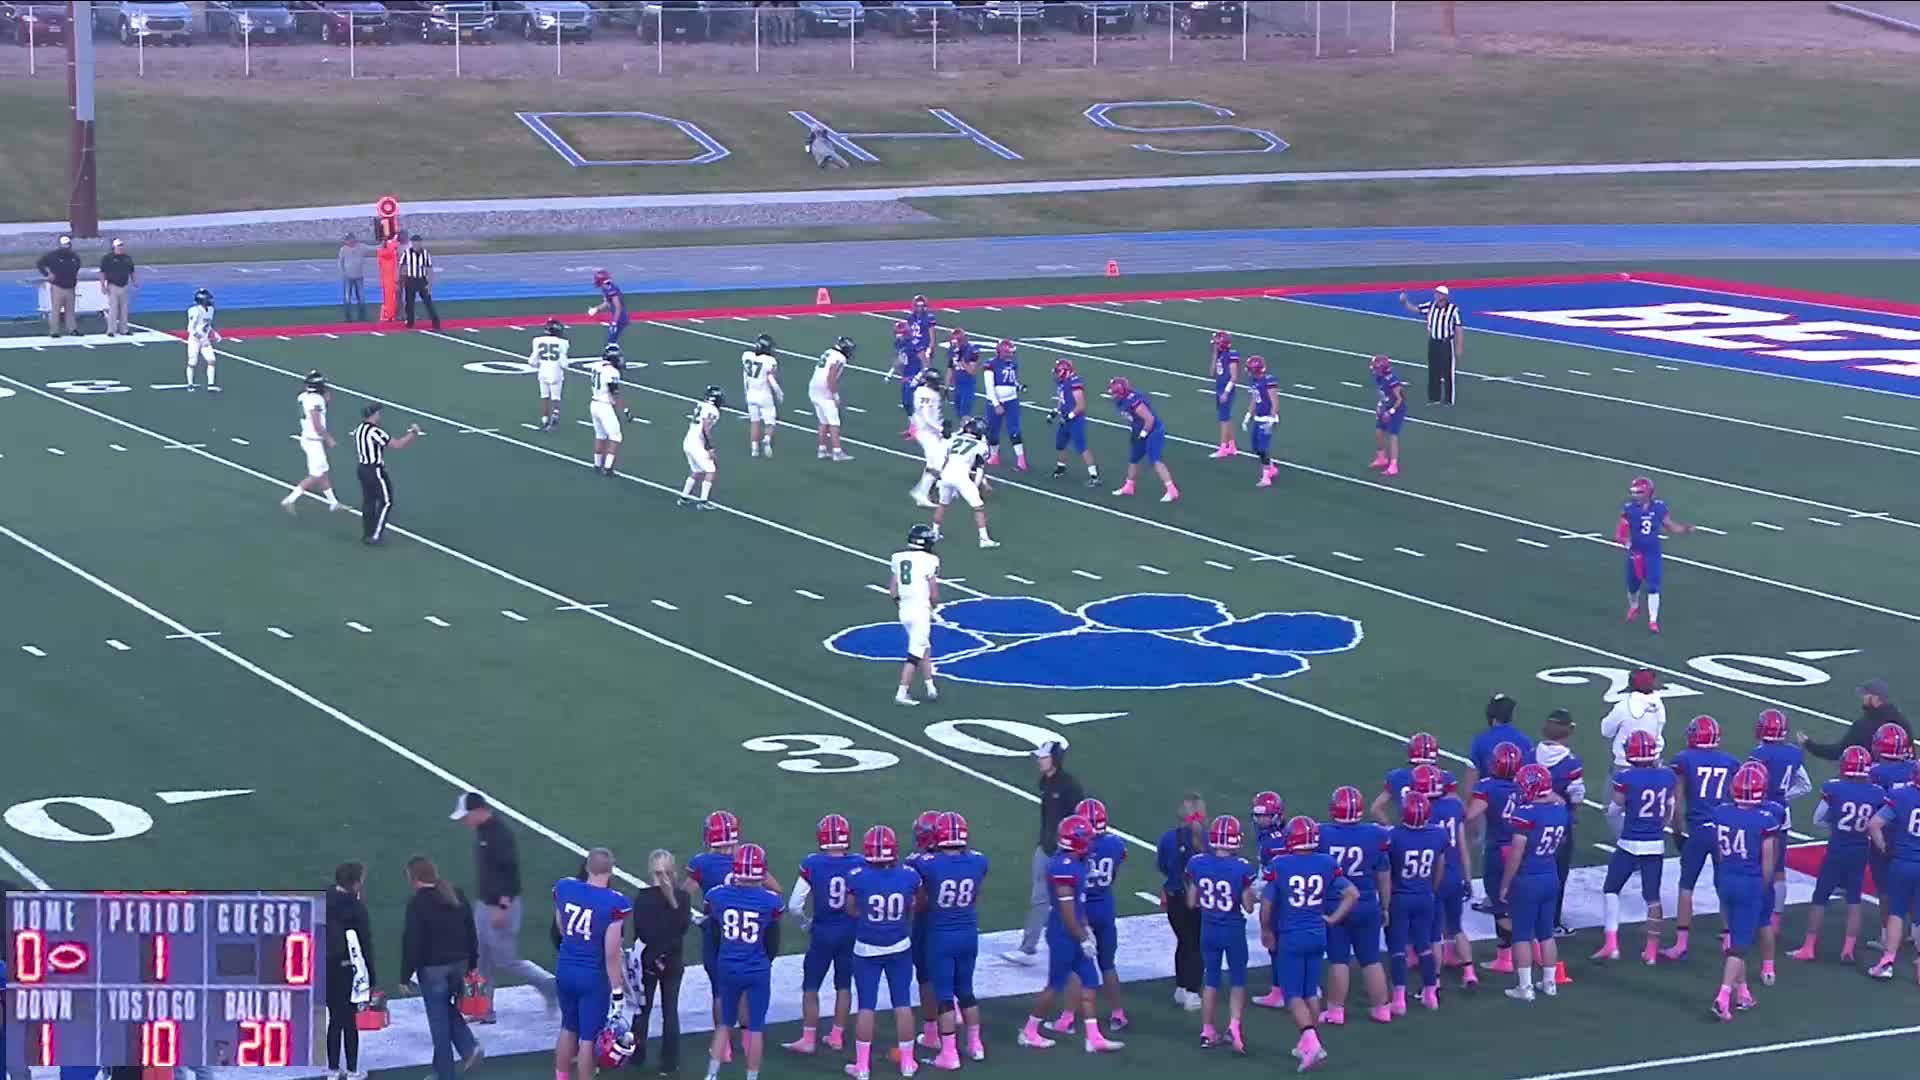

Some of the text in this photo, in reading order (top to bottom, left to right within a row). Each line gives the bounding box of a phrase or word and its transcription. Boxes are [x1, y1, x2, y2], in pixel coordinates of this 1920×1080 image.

[514, 100, 1292, 166] DHS
[538, 342, 559, 361] 25
[951, 438, 977, 456] 27
[1640, 520, 1652, 535] 3
[899, 560, 913, 585] 8
[1697, 766, 1728, 800] 77
[1639, 787, 1668, 818] 21
[1837, 802, 1873, 832] 28
[1716, 825, 1748, 860] 54
[1329, 846, 1364, 877] 72
[1401, 849, 1435, 880] 58
[938, 878, 975, 908] 68
[1198, 878, 1234, 912] 33
[1288, 874, 1325, 908] 32
[564, 902, 593, 941] 74
[867, 892, 905, 922] 30
[722, 908, 760, 944] 85
